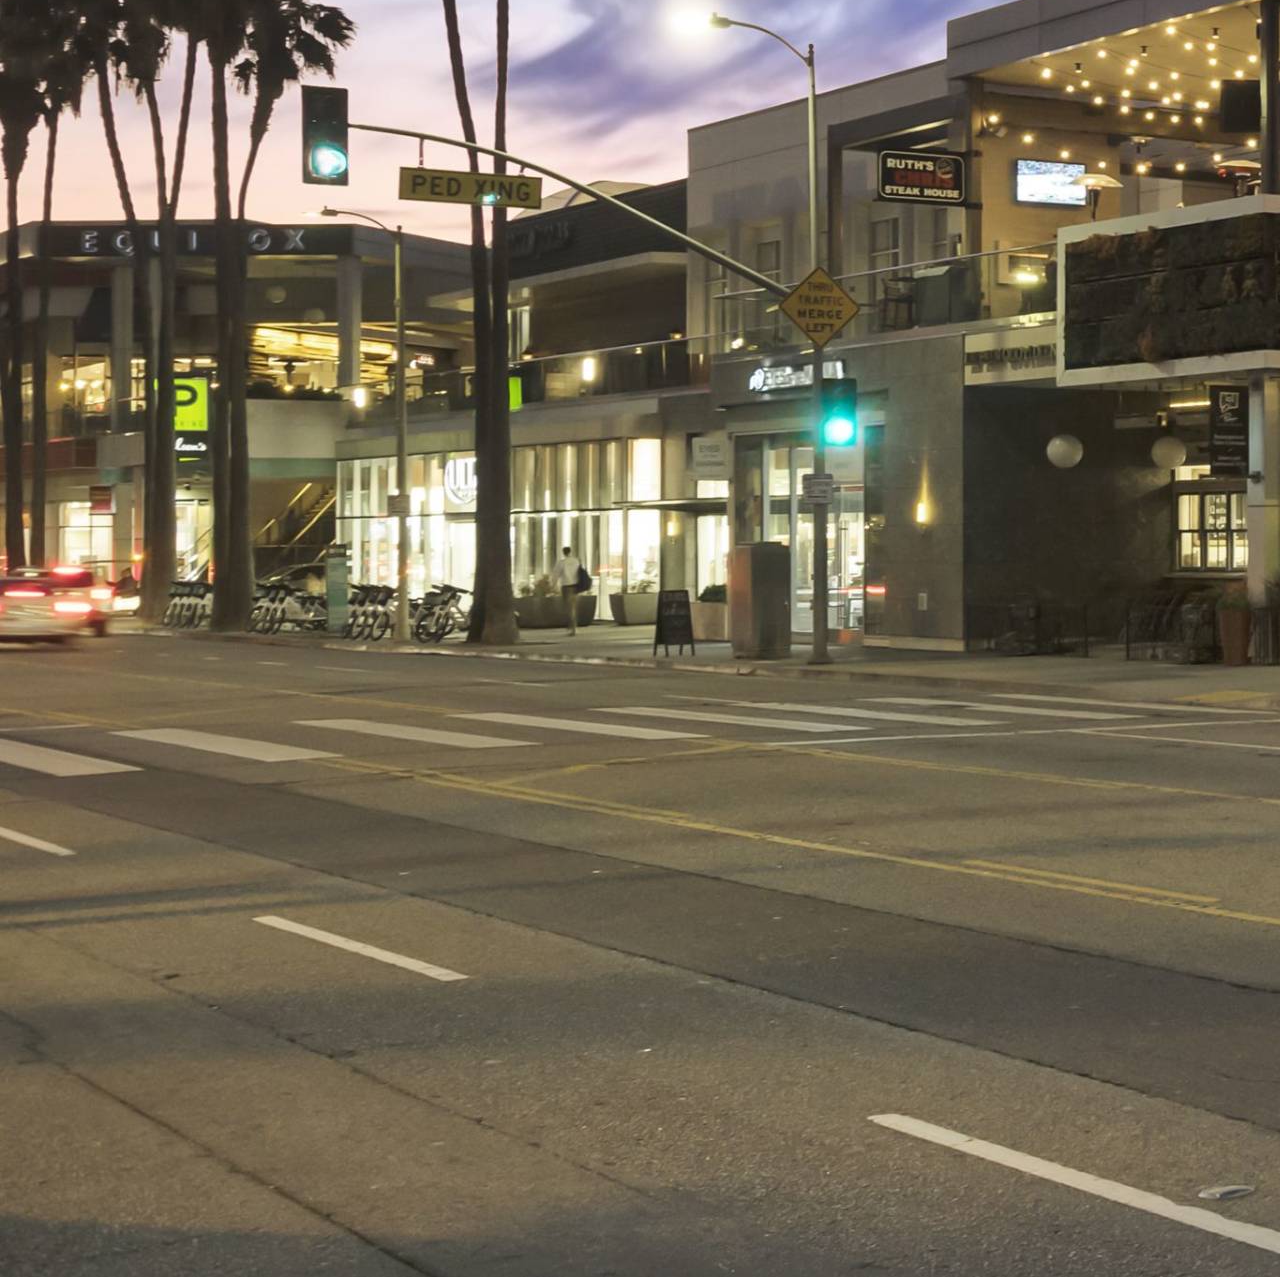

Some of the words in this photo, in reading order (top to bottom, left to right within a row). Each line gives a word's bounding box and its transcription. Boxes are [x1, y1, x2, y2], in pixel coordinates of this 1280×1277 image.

[886, 158, 935, 171] RUTH'S
[411, 174, 461, 197] PED
[473, 179, 530, 202] XING
[884, 185, 921, 196] STEAK
[923, 188, 960, 199] HOUSE
[80, 229, 305, 256] EQUIOX
[807, 281, 834, 292] THRU
[799, 295, 844, 306] TRAFFIC
[797, 308, 843, 320] MERGE
[806, 323, 834, 333] LEFT
